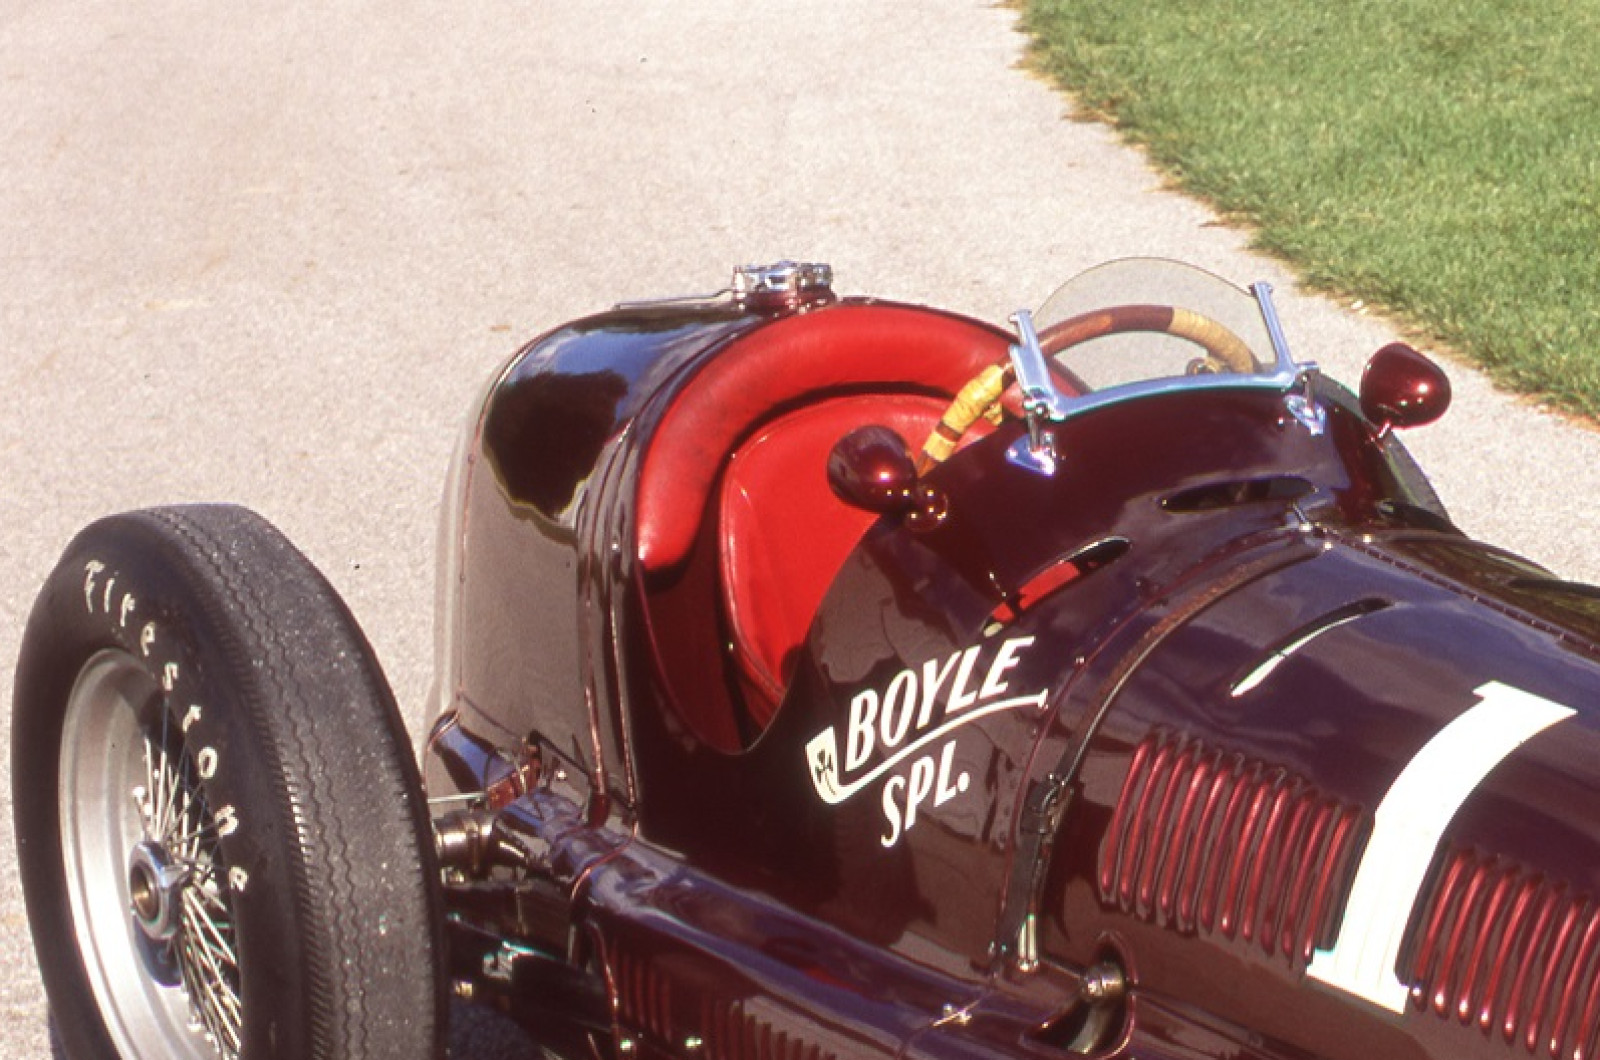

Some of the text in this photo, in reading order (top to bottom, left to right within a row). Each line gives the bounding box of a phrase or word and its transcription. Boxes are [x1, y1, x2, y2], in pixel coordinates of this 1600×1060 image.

[83, 559, 249, 892] Firestone
[843, 635, 1036, 772] BOYLE
[879, 740, 971, 848] SPL.
[1305, 680, 1578, 1015] 1
